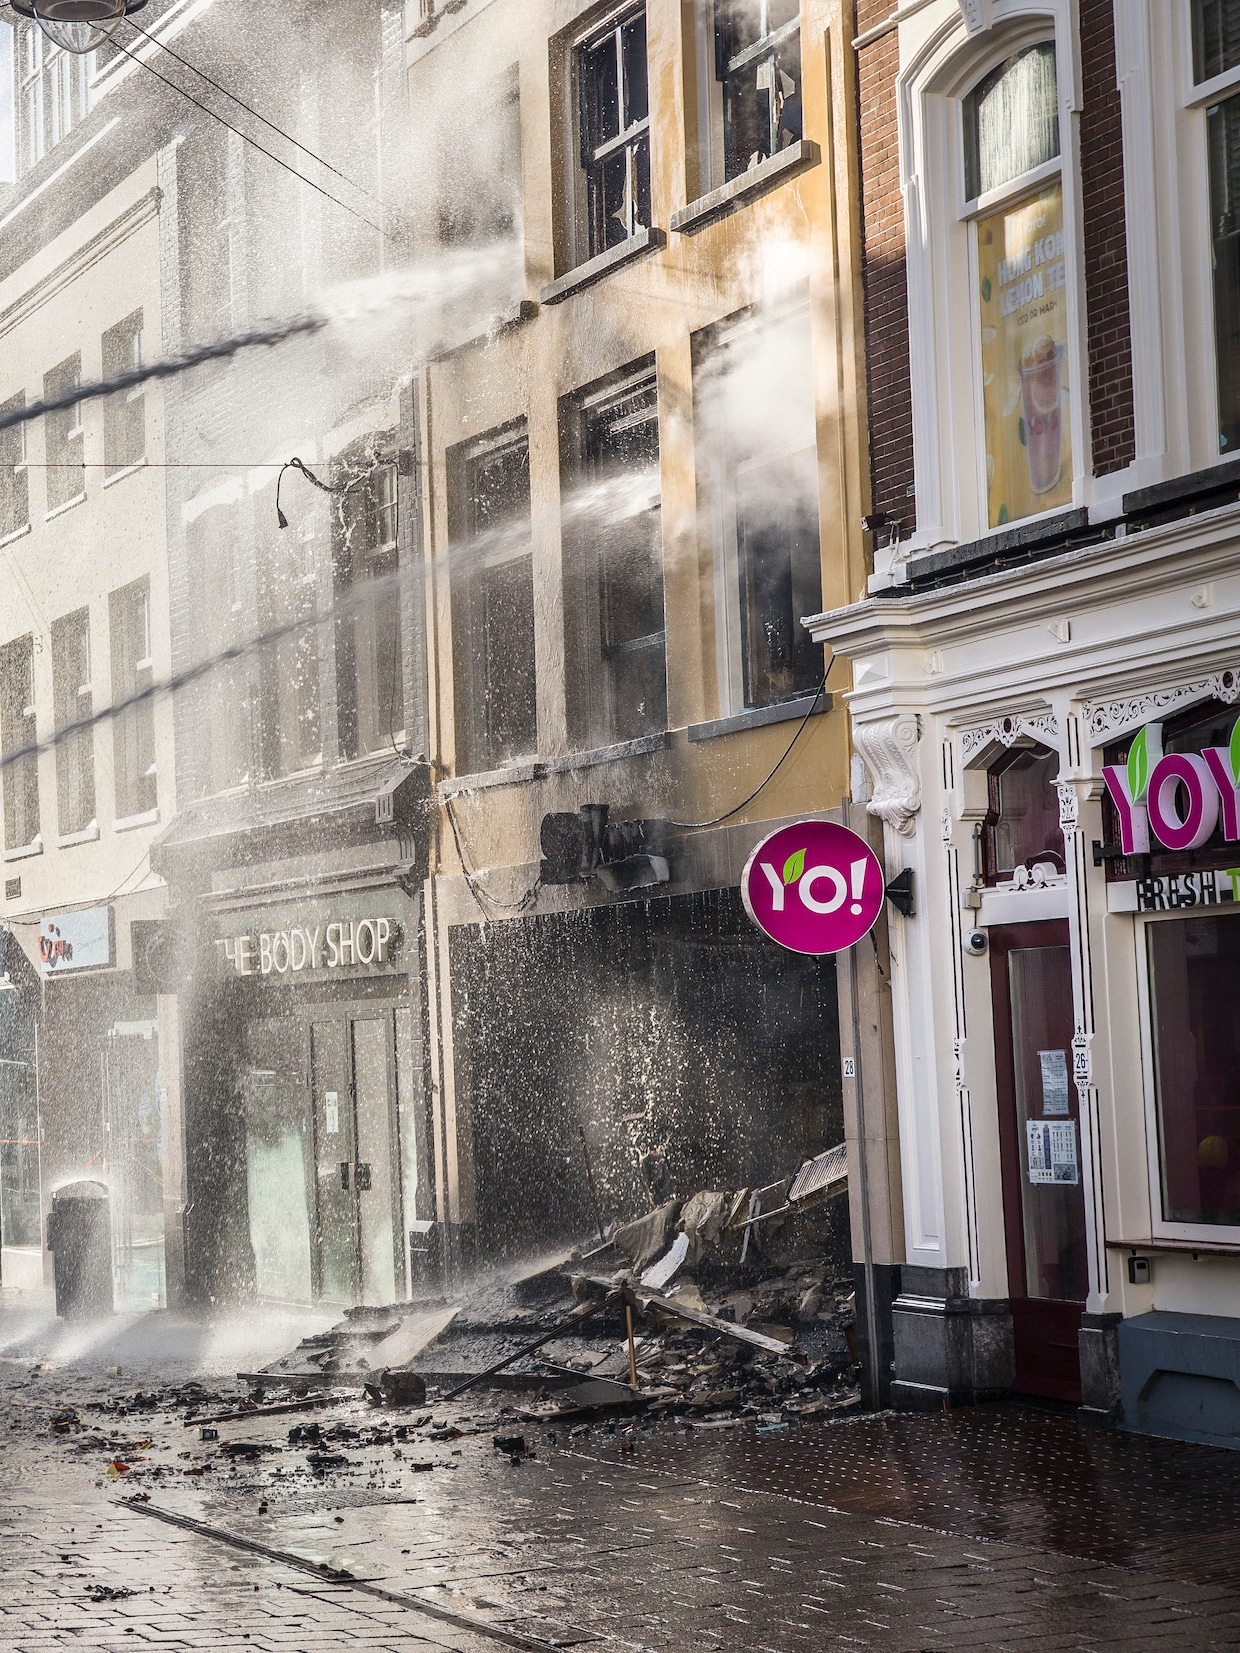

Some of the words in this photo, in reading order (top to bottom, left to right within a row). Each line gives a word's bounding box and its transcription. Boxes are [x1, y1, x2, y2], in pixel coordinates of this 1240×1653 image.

[1000, 271, 1045, 318] LEMON
[759, 848, 869, 916] YO!
[1136, 870, 1221, 913] FRESH
[259, 926, 320, 974] BODY
[326, 918, 390, 968] SHOP
[845, 1060, 854, 1075] 28
[1075, 1053, 1086, 1069] 26
